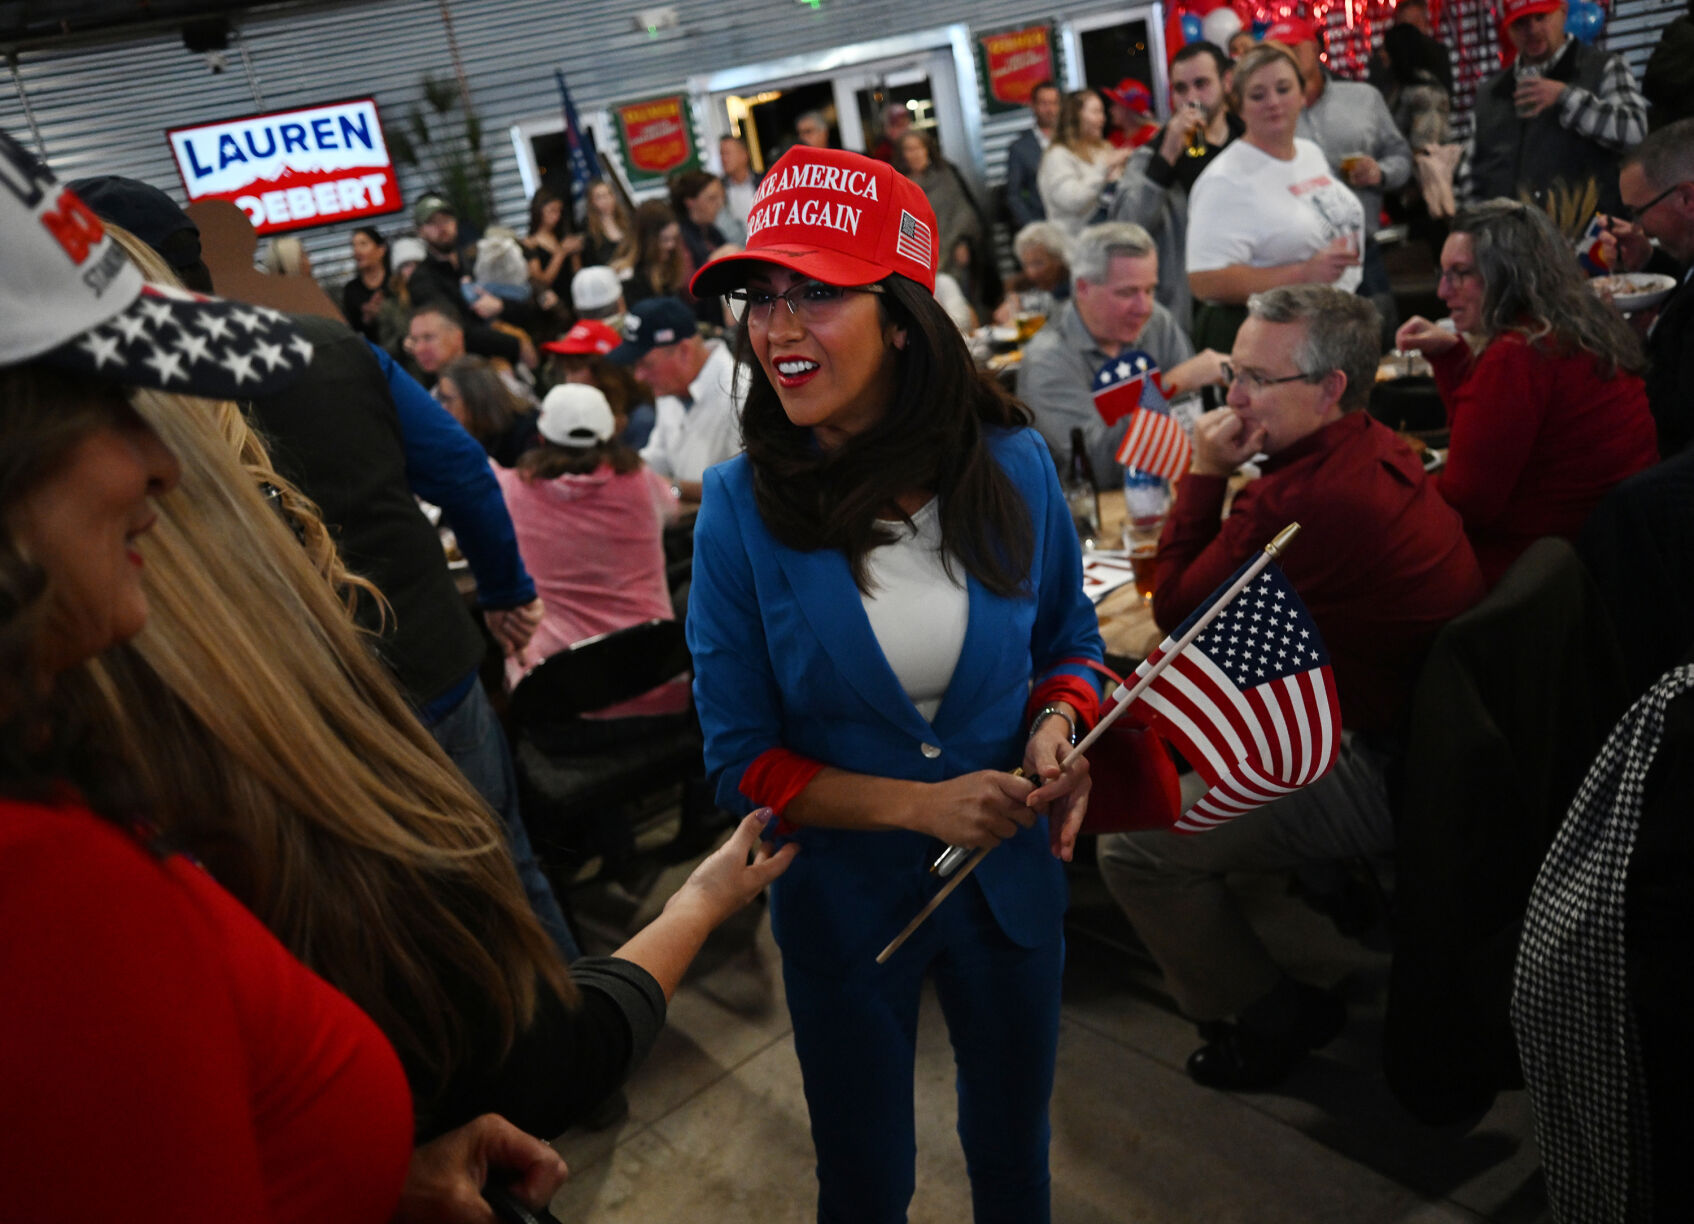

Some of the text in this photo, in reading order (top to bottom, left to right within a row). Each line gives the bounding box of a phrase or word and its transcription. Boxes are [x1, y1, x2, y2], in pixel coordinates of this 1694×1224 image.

[183, 112, 374, 179] LAUREN
[234, 173, 387, 228] OEBERT
[776, 163, 879, 202] AMERICA
[746, 199, 863, 242] REAT AGAIN
